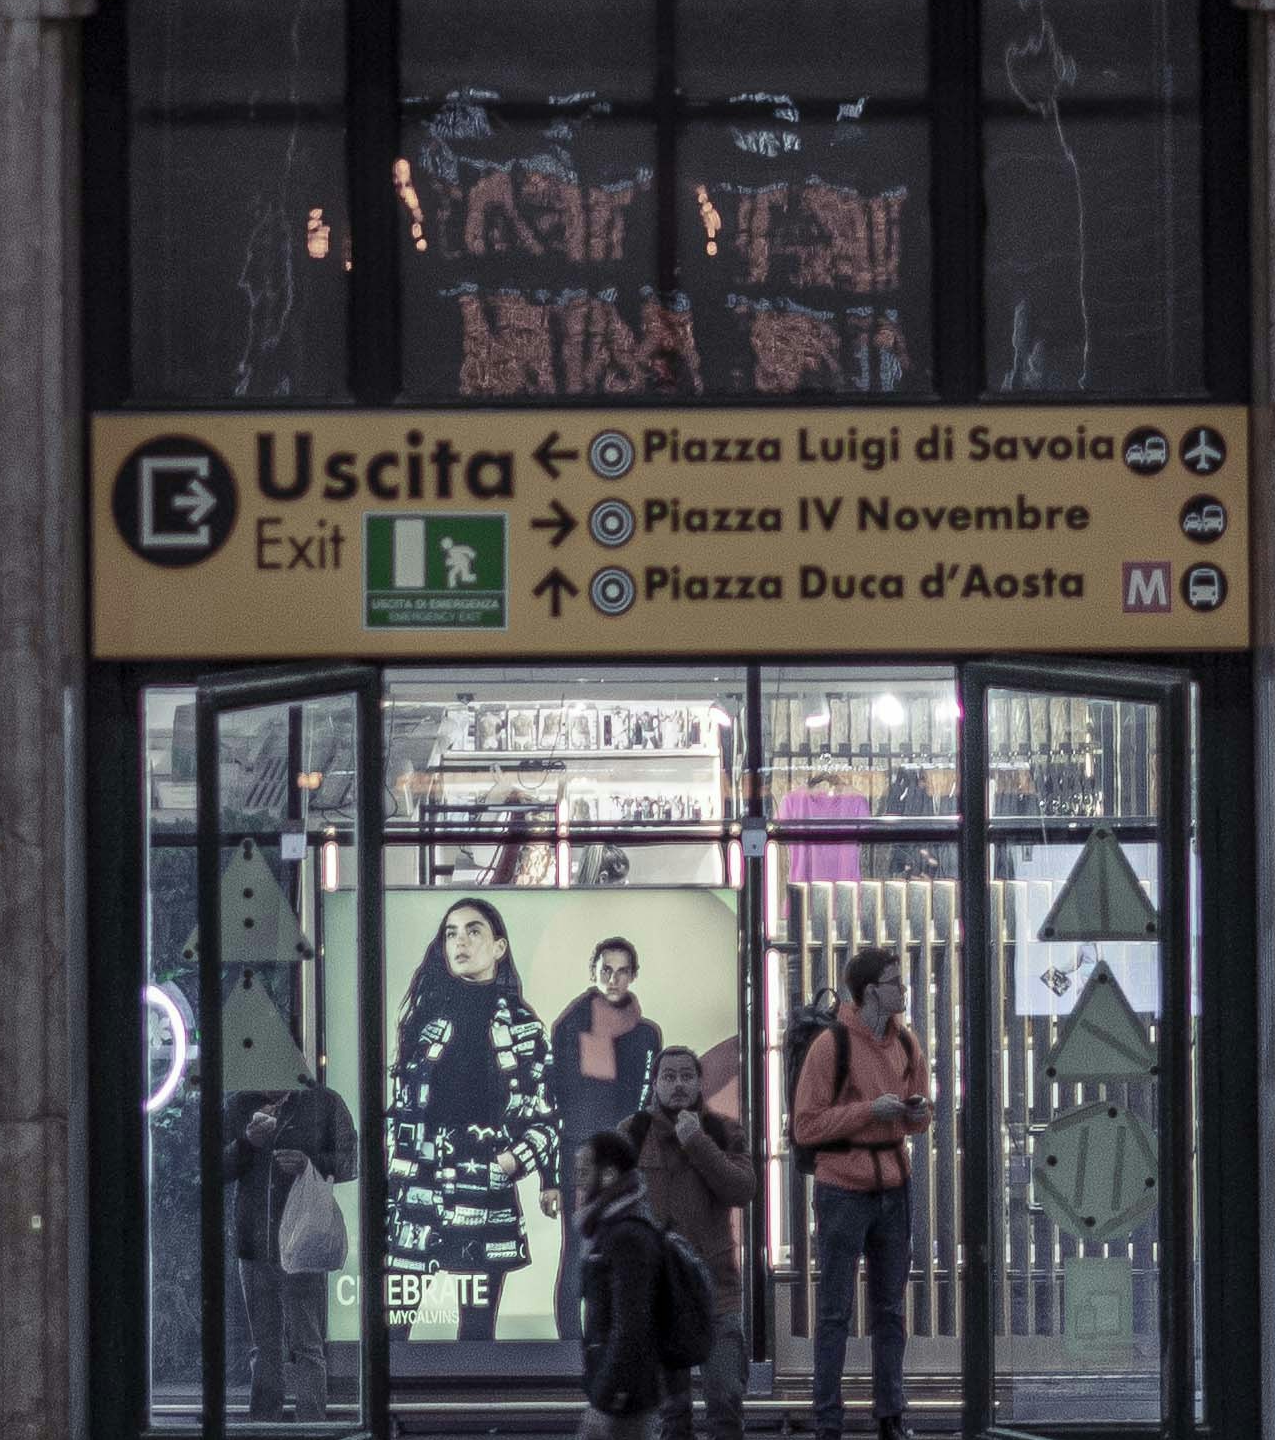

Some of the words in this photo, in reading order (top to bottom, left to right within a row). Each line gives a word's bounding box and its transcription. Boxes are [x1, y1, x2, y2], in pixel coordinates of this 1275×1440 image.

[255, 432, 515, 501] Uscita
[643, 428, 781, 465] Piazza
[796, 427, 901, 472] Luigi
[915, 426, 956, 463] di
[966, 426, 1116, 463] Savoia
[643, 498, 781, 535] Piazza
[798, 497, 845, 532] IV
[856, 495, 1091, 533] Novembre
[255, 517, 346, 572] Exit
[643, 567, 781, 603] Piazza
[798, 565, 906, 600] Duca
[919, 563, 1086, 600] d'Aosta
[336, 1274, 490, 1306] CEBRATE
